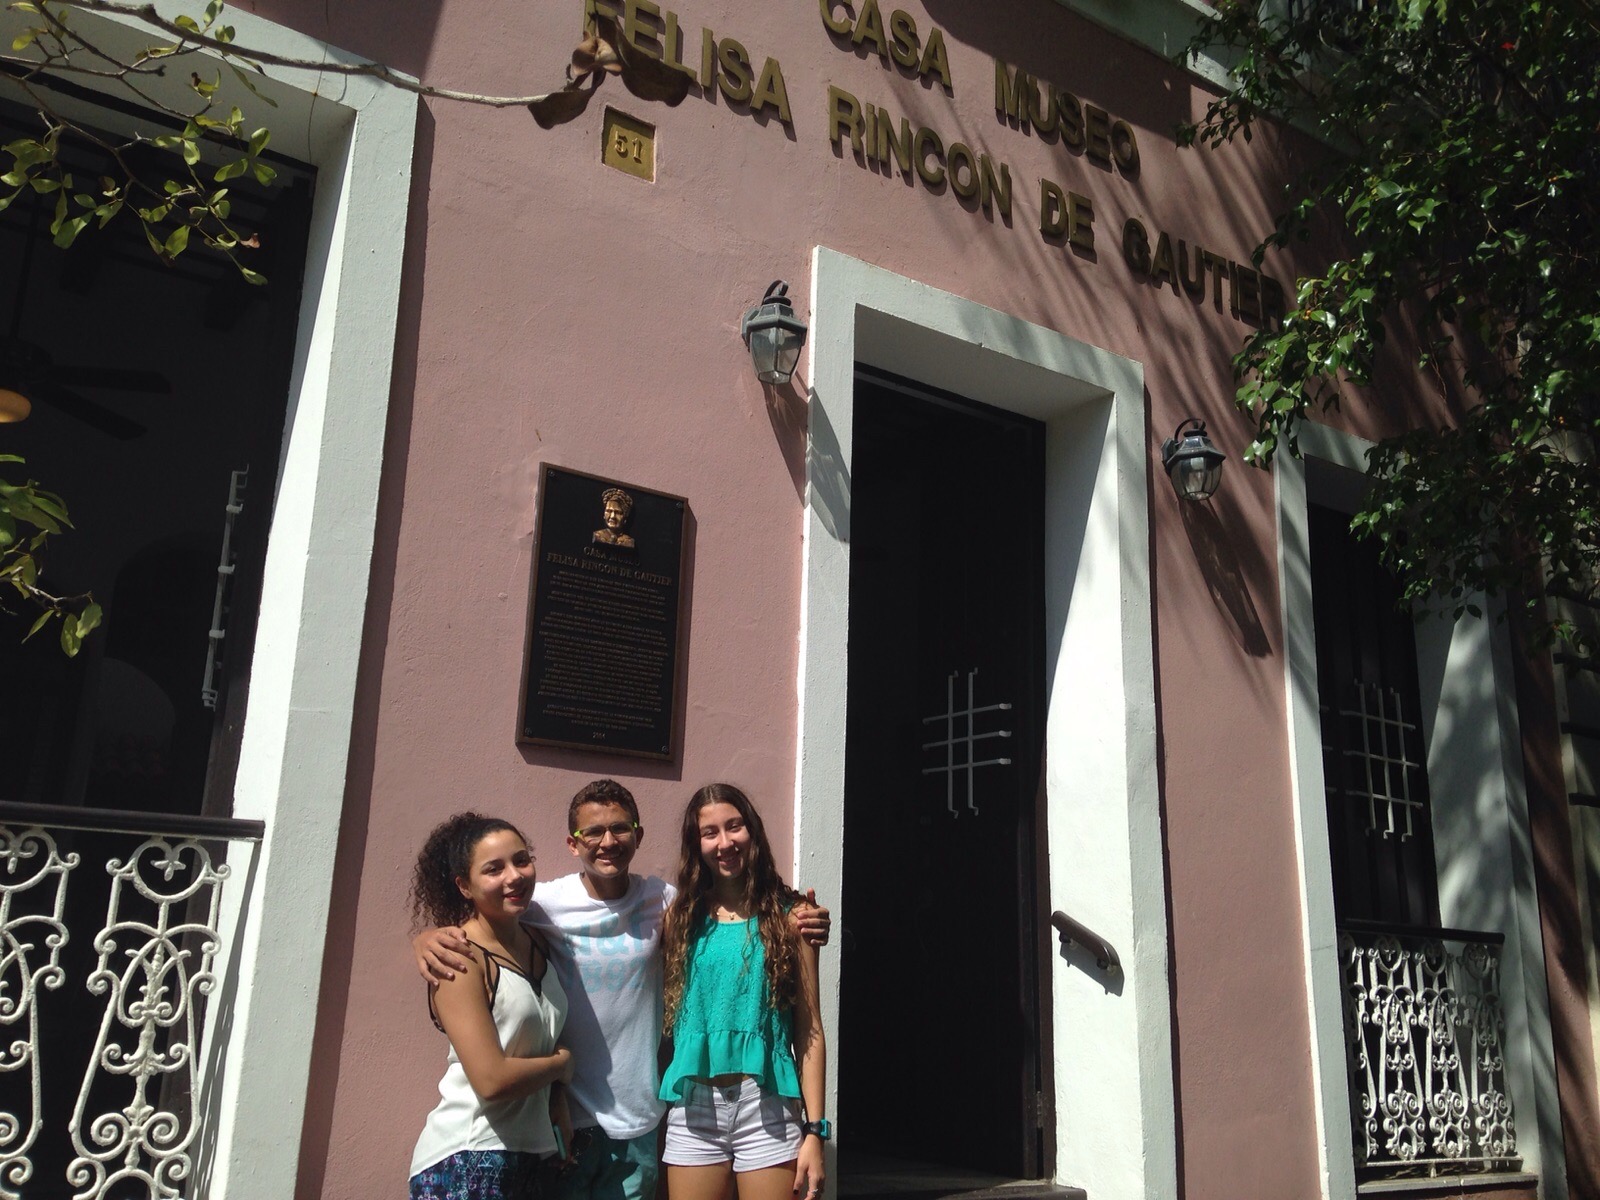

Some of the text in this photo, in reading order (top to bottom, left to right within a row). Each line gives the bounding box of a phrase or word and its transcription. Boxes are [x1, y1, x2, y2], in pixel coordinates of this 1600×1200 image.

[820, 0, 1139, 170] CASA MUSEO
[613, 130, 643, 163] 51
[829, 85, 1012, 219] RINCON
[1040, 178, 1093, 246] DE
[1123, 218, 1285, 331] GAUTIER
[546, 552, 579, 568] FELISA
[620, 567, 633, 578] DE
[634, 570, 673, 586] GAUTIER
[583, 546, 607, 559] CASA
